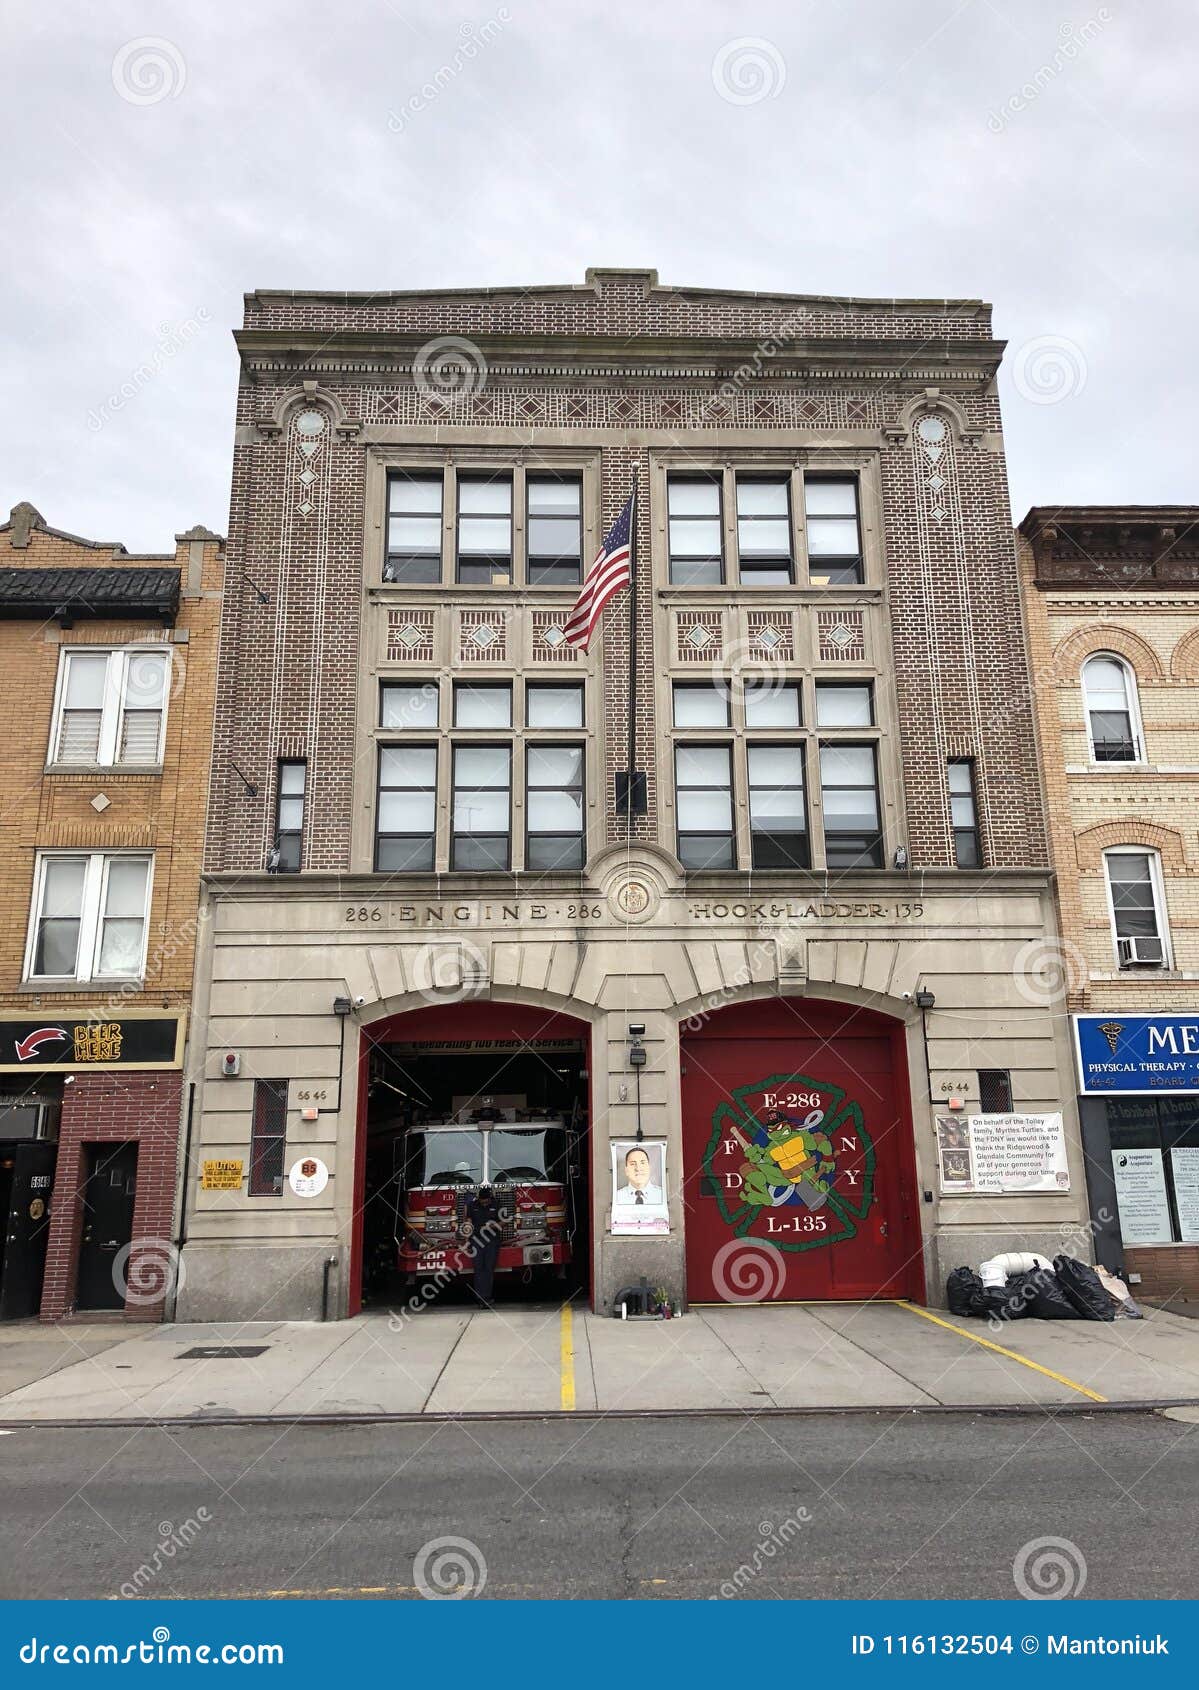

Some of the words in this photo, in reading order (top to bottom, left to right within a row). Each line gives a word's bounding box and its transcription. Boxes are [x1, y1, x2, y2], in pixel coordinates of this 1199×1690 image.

[345, 907, 382, 922] 286
[399, 905, 548, 921] ENGINE
[567, 905, 602, 919] 286
[895, 903, 924, 918] 135
[74, 1023, 123, 1043] BEER
[74, 1041, 121, 1062] HERE
[1088, 1063, 1137, 1072] PHYSICAL
[1139, 1062, 1187, 1071] THERAPY
[941, 1082, 953, 1092] 66
[956, 1082, 970, 1092] 44
[1149, 1076, 1186, 1086] BOARD
[763, 1093, 821, 1108] E-286
[723, 1140, 738, 1155] F
[841, 1137, 857, 1151] N
[1006, 1152, 1044, 1160] Community
[1011, 1161, 1041, 1169] generous
[725, 1173, 743, 1188] D
[844, 1170, 860, 1185] Y
[1004, 1170, 1027, 1178] during
[767, 1216, 827, 1232] L-135
